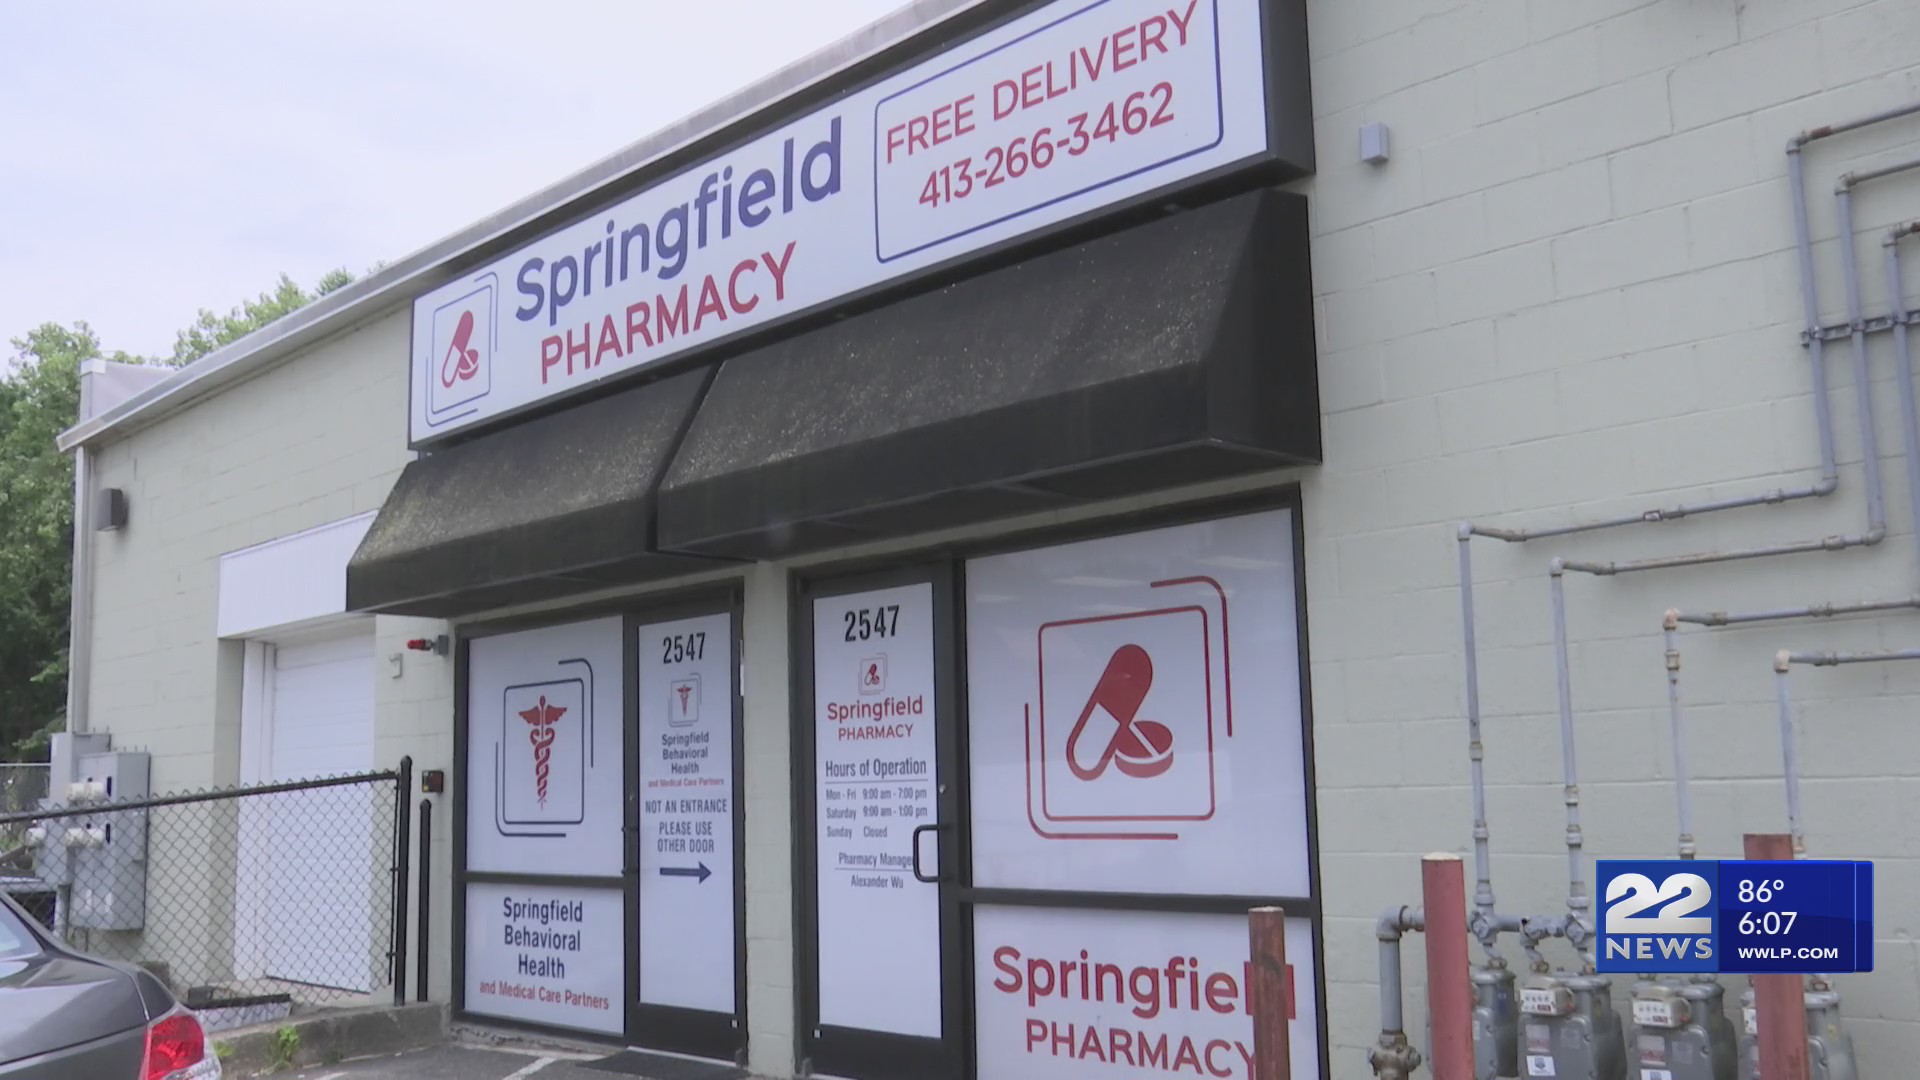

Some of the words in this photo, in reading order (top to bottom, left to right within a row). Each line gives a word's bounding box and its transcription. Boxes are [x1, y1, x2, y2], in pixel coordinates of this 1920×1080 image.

[886, 94, 976, 164] FREE
[993, 0, 1197, 121] DELIVERY
[919, 81, 1175, 209] 413-266-3462
[515, 115, 842, 327] Springfield
[541, 240, 797, 385] PHARMACY
[844, 604, 900, 643] 2547
[662, 632, 706, 664] 2547
[827, 694, 923, 724] Springfield
[661, 731, 709, 747] Springfield
[838, 723, 914, 741] PHARMACY
[662, 746, 709, 761] Behavioral
[671, 761, 700, 775] Health
[825, 760, 856, 778] Hours
[859, 759, 870, 776] of
[873, 757, 927, 779] Operation
[648, 779, 658, 788] and
[660, 778, 682, 788] Medical
[684, 777, 697, 787] Care
[699, 776, 725, 787] Partners
[825, 789, 841, 801] Mon
[847, 788, 857, 800] Fri
[862, 787, 878, 800] 9:00
[880, 788, 892, 799] am
[898, 786, 914, 800] 7:00
[915, 788, 928, 801] pm
[645, 799, 662, 814] NOT
[665, 800, 677, 813] AN
[680, 798, 728, 813] ENTRANCE
[826, 807, 857, 820] Saturday
[862, 804, 879, 818] 9:00
[880, 806, 892, 817] am
[899, 804, 914, 817] 1:00
[916, 806, 928, 819] pm
[660, 821, 691, 836] PLEASE
[695, 821, 713, 836] USE
[827, 825, 853, 840] Sunday
[863, 825, 888, 838] Closed
[657, 838, 686, 853] OTHER
[689, 838, 715, 853] DOOR
[838, 851, 877, 868] Pharmacy
[879, 853, 915, 868] Manage
[851, 874, 889, 888] Alexander
[503, 896, 583, 925] Springfield
[504, 924, 581, 952] Behavioral
[518, 953, 565, 979] Health
[479, 980, 496, 995] and
[499, 980, 536, 1001] Medical
[538, 985, 562, 1004] Care
[564, 989, 610, 1011] Partners
